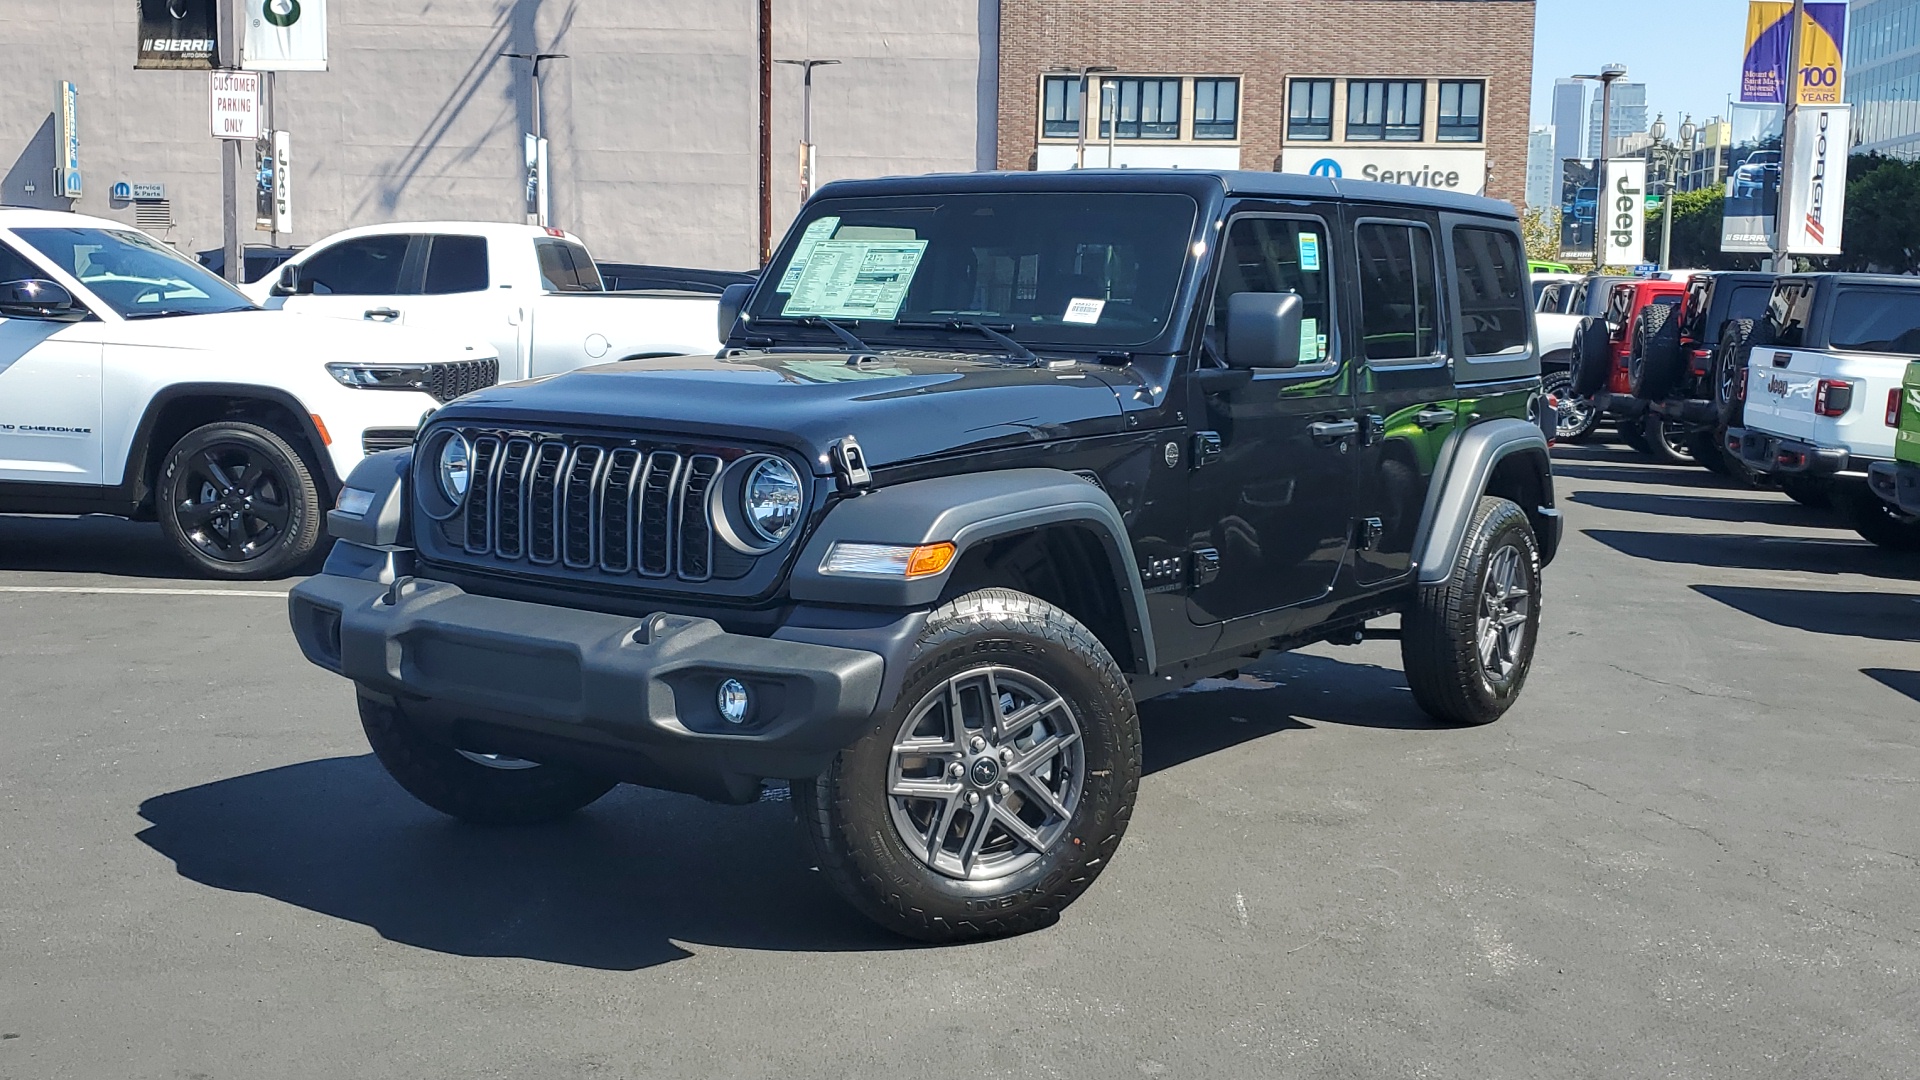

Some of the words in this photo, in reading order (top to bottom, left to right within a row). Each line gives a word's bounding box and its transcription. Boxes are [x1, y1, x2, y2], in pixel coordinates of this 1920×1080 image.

[153, 39, 214, 51] SIERRA
[1744, 70, 1767, 78] Mount
[1799, 67, 1837, 87] 100
[213, 76, 256, 92] CUSTOMER
[1744, 84, 1776, 93] University
[217, 97, 251, 113] PARKING
[1801, 93, 1836, 102] YEARS
[224, 118, 244, 133] ONLY
[1361, 163, 1460, 188] Service
[1812, 112, 1828, 225] DODGE
[276, 149, 288, 216] Jeep
[1610, 174, 1641, 248] Jeep
[1732, 234, 1771, 242] SIERRA
[1768, 374, 1788, 399] Jeep
[19, 425, 92, 433] CHEROKEE
[1140, 555, 1182, 581] Jeep
